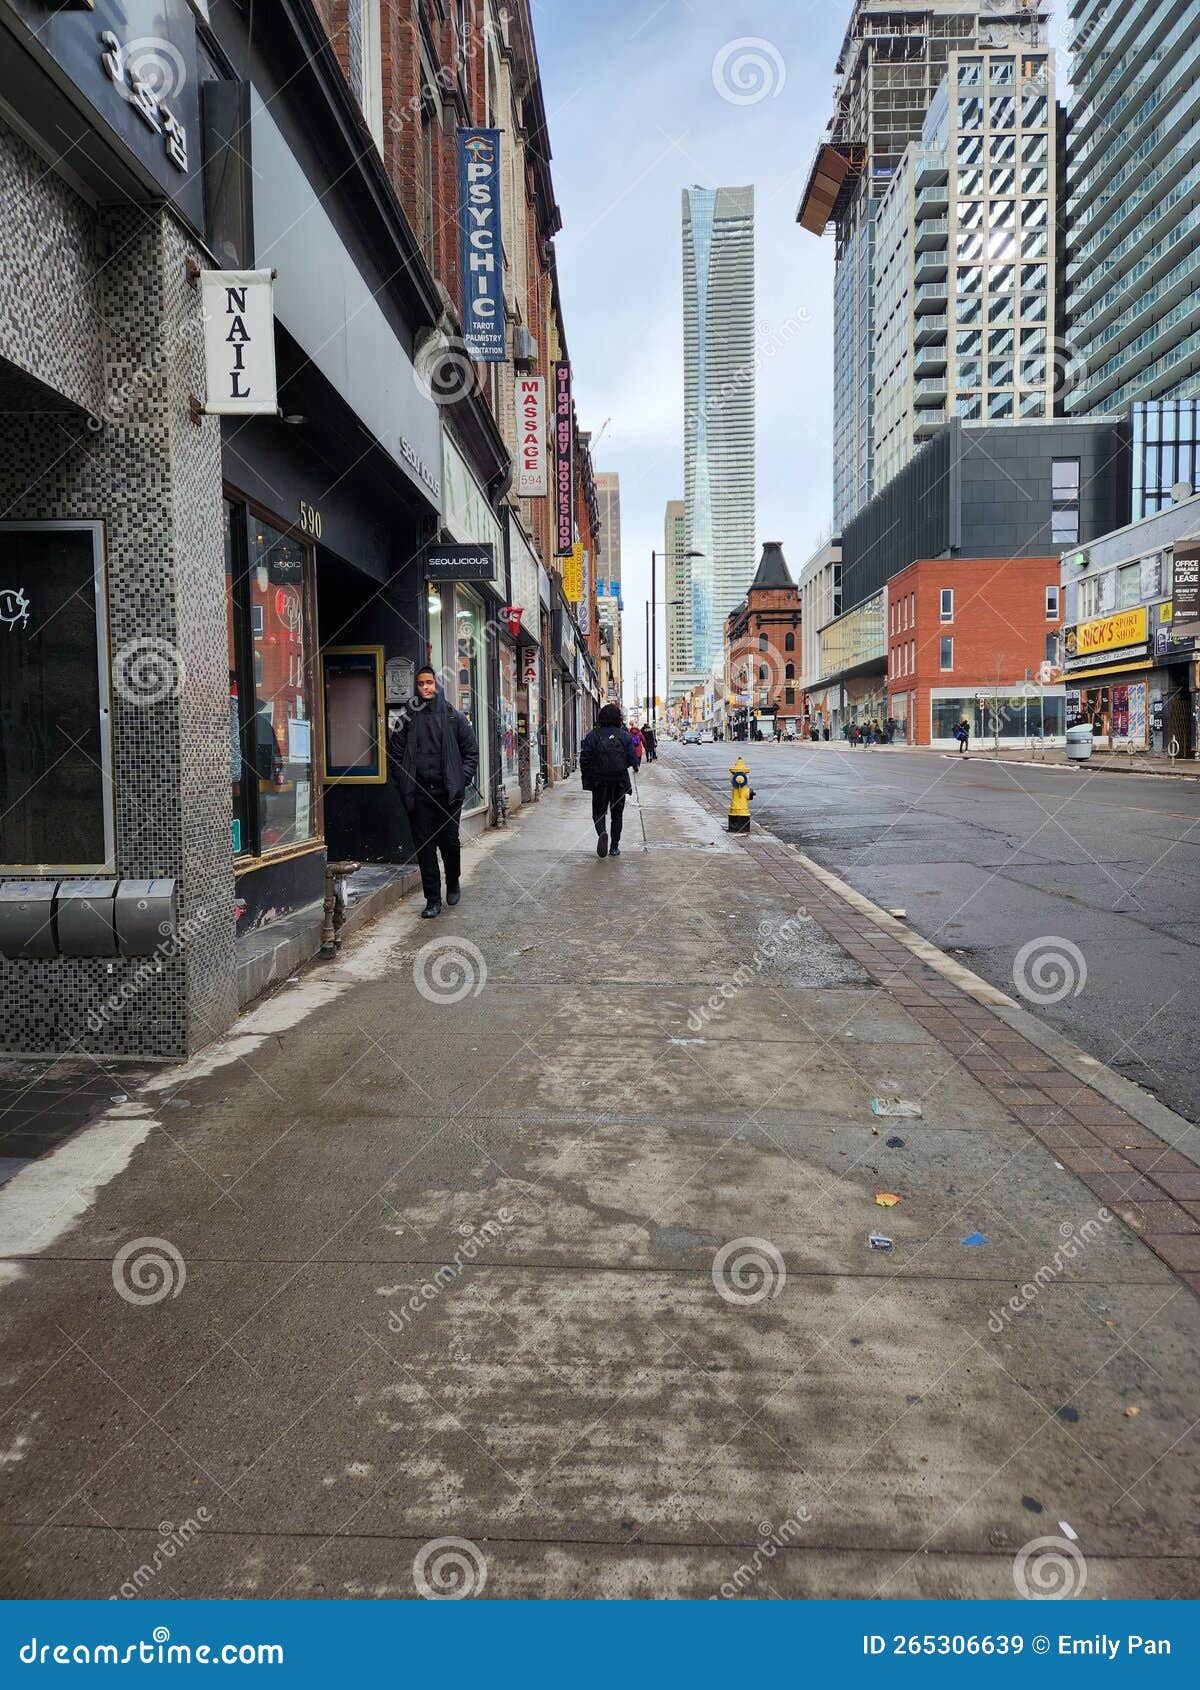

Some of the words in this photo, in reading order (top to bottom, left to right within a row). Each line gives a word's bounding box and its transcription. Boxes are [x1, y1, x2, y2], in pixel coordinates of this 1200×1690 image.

[467, 163, 496, 317] PSYCHIC
[472, 321, 495, 330] TAROT
[225, 287, 251, 398] NAIL
[465, 334, 502, 342] PALMISTRY
[466, 346, 503, 355] MEDITATION
[521, 381, 539, 470] MASSAGE
[521, 475, 542, 485] 594
[300, 499, 322, 539] 590
[428, 557, 489, 566] SEOULICIOUS
[1174, 559, 1199, 567] OFFICE
[1174, 574, 1199, 583] LEASE
[1083, 621, 1114, 647] NICK'S
[1115, 614, 1138, 629] SPORT
[1115, 627, 1136, 641] SHOP
[524, 648, 537, 677] SPA
